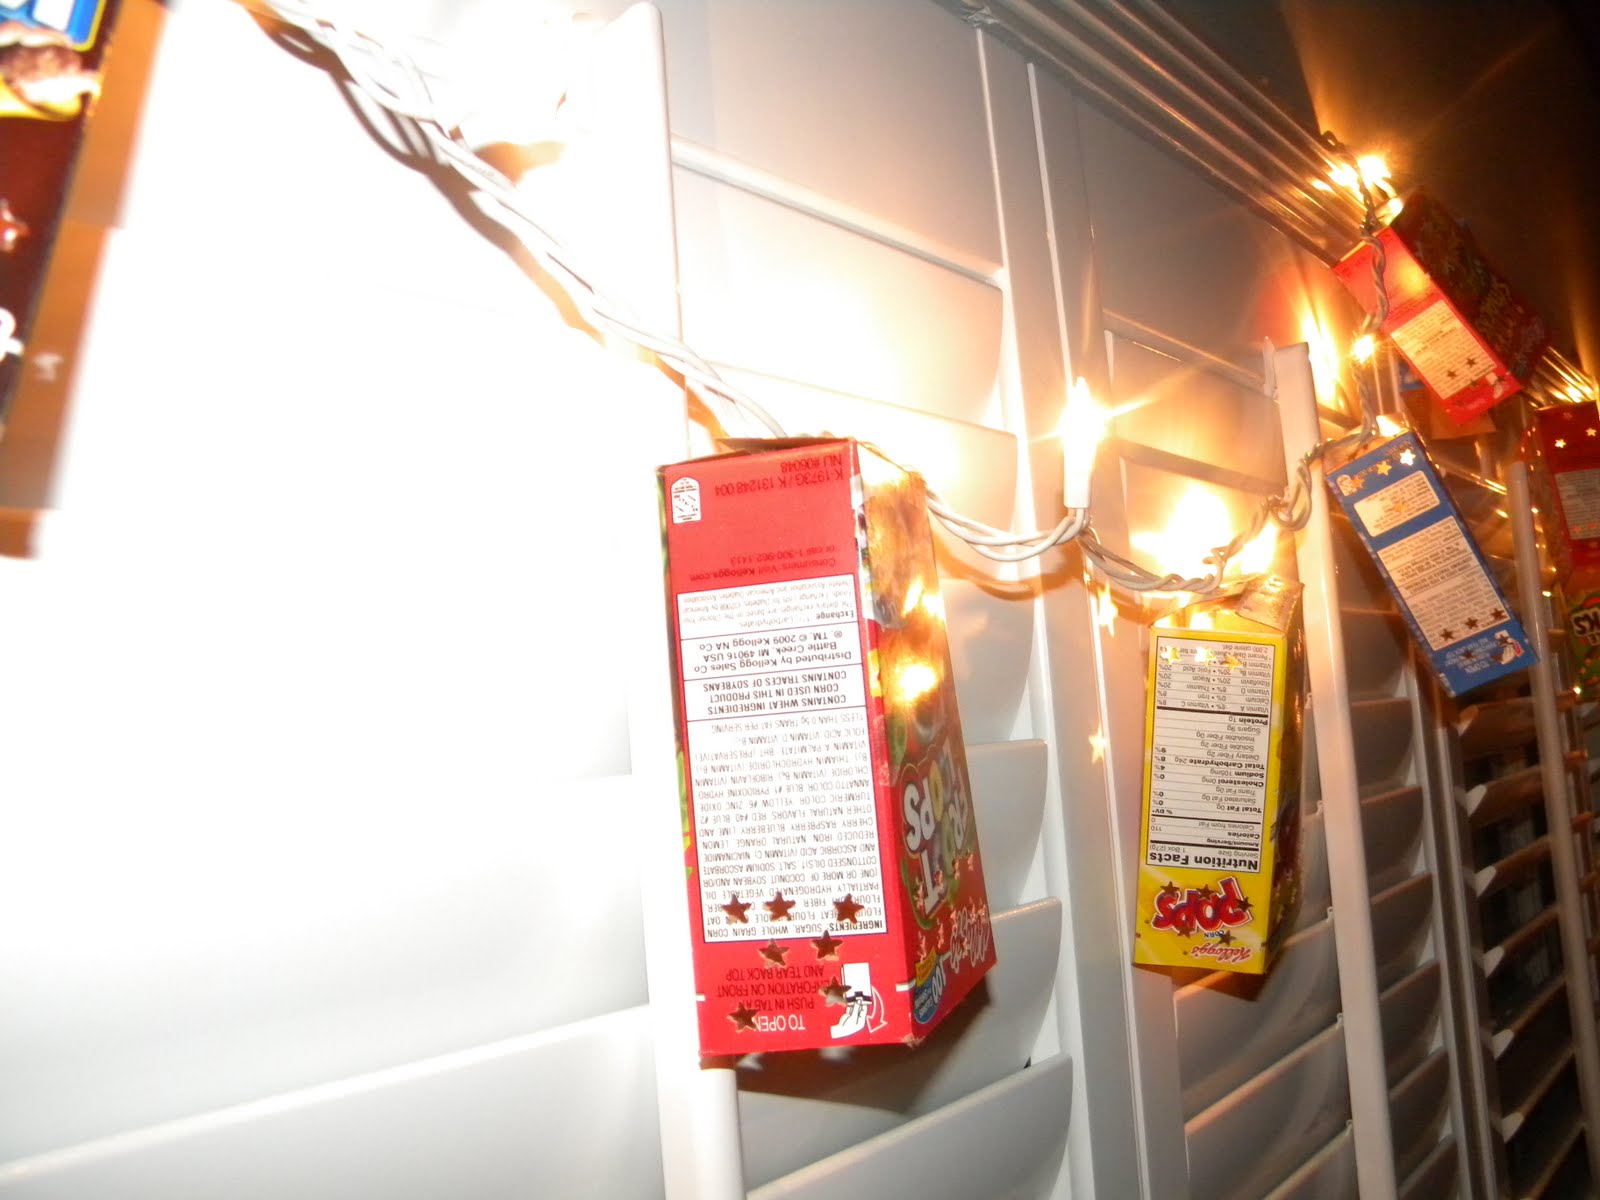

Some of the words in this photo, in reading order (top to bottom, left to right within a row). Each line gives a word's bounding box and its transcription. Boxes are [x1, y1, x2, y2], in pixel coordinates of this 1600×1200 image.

[732, 634, 769, 648] Kellogg
[772, 634, 796, 644] 2009
[715, 641, 729, 650] NA
[807, 640, 836, 651] Battle
[702, 652, 723, 662] USA
[726, 649, 754, 659] 49016
[757, 648, 769, 656] MI
[795, 650, 851, 664] Distributed
[739, 655, 777, 670] Kellogg
[780, 654, 792, 665] by
[710, 662, 736, 672] Sales
[764, 674, 798, 685] TRACES
[801, 669, 846, 682] CONTAINS
[751, 678, 762, 687] OF
[813, 682, 838, 693] CORN
[752, 688, 772, 699] THIS
[774, 687, 784, 696] IN
[786, 685, 810, 695] USED
[768, 698, 798, 709] WHEAT
[801, 693, 846, 706] CONTAINS
[1188, 758, 1242, 768] Carbohydrate
[1234, 770, 1264, 778] Sodium
[1217, 778, 1263, 786] Cholesterol
[1149, 843, 1166, 851] (27g)
[1149, 852, 1188, 864] Facts
[1233, 850, 1258, 858] Serving
[1193, 855, 1258, 870] Nutrition
[1152, 876, 1254, 934] POPS
[731, 926, 756, 936] GRAIN
[761, 924, 788, 935] WHOLE
[792, 921, 821, 933] SUGAR,
[706, 928, 728, 938] CORN
[724, 968, 744, 981] TOP
[747, 967, 772, 980] BACK
[774, 965, 802, 978] TEAR
[803, 964, 824, 977] AND
[716, 983, 748, 997] FRONT
[751, 982, 765, 996] ON
[774, 998, 784, 1009] IN
[786, 996, 814, 1009] PUSH
[789, 1013, 805, 1030] TO
